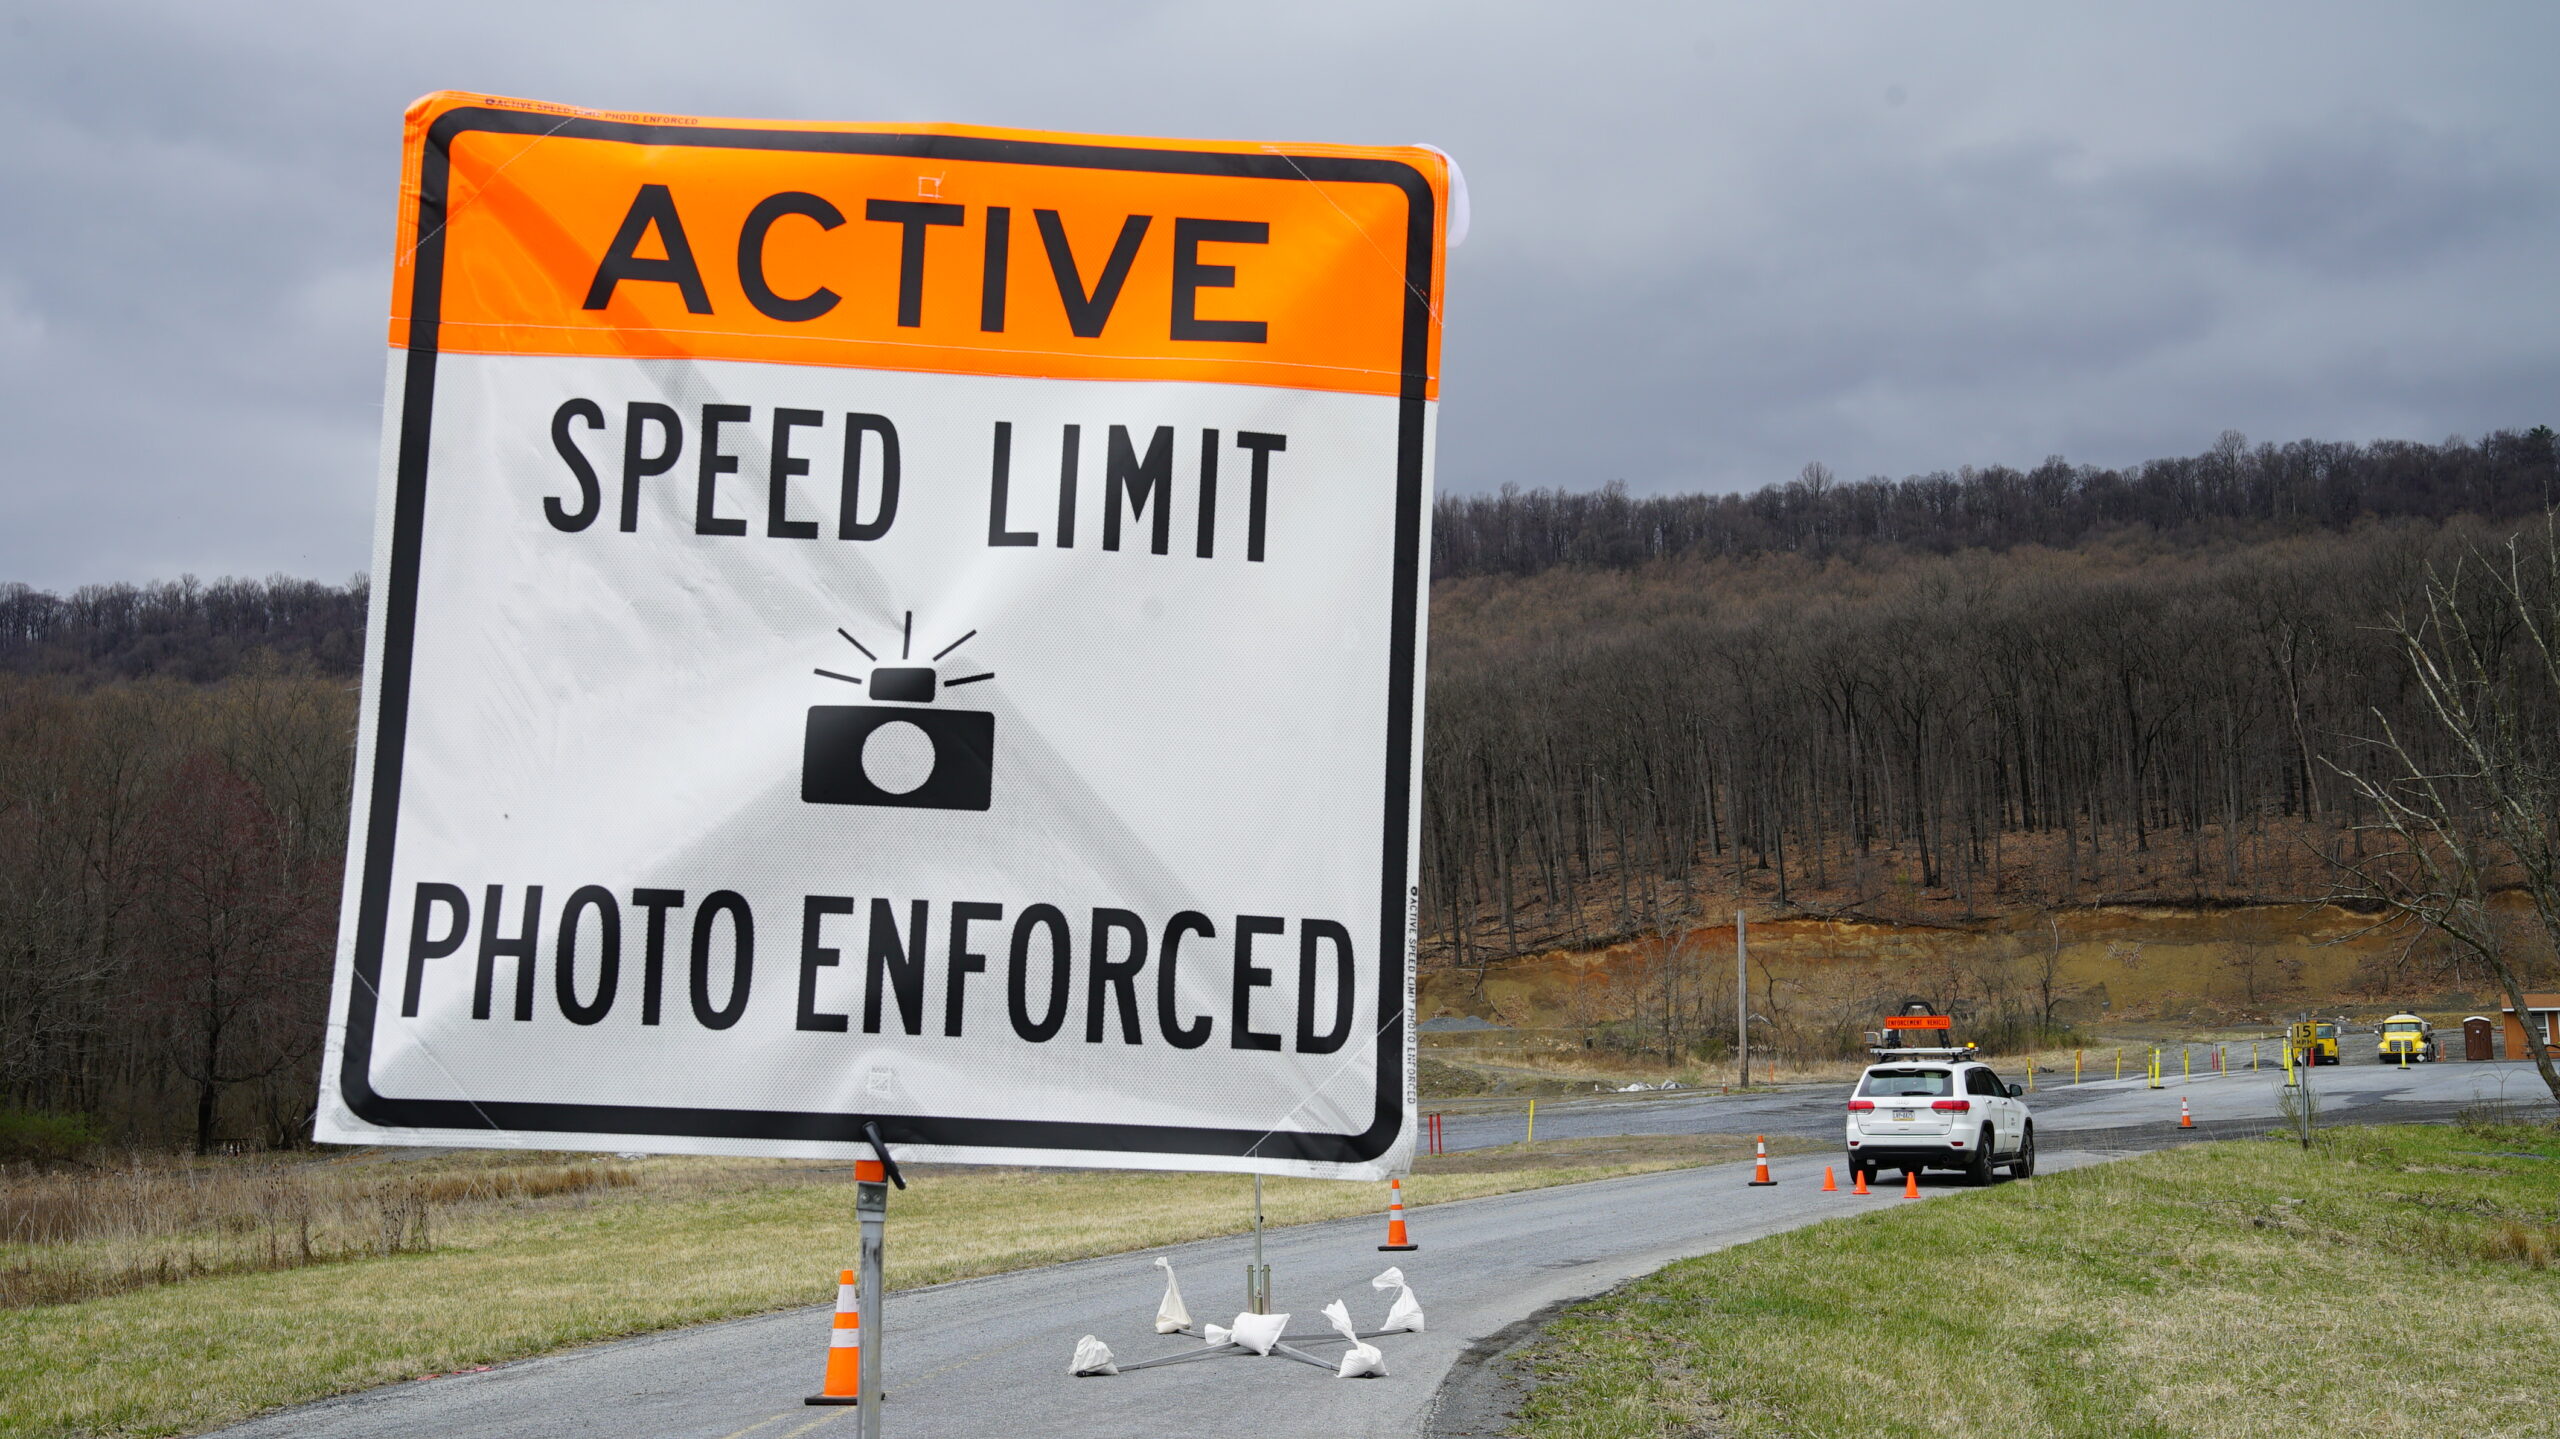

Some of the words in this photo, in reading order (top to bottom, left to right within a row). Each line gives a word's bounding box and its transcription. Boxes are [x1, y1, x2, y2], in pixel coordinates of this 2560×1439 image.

[496, 99, 532, 109] ACTIVE
[537, 104, 571, 113] SPEED
[605, 113, 639, 122] PHOTO
[642, 115, 699, 125] ENFORCED
[583, 184, 1269, 344] ACTIVE
[543, 398, 901, 542] SPEED
[988, 421, 1287, 563] LIMIT
[1409, 897, 1418, 935] ACTIVE
[401, 882, 755, 1031] PHOTO
[795, 894, 1355, 1055] ENFORCED
[1408, 938, 1416, 972] SPEED
[1407, 977, 1416, 1003] LIMIT
[1407, 1008, 1416, 1043] PHOTO
[1887, 1019, 1922, 1027] ENFORCEMENT
[1927, 1019, 1948, 1027] VEHICLE
[2296, 1025, 2312, 1038] 15
[1406, 1047, 1416, 1105] ENFORCED
